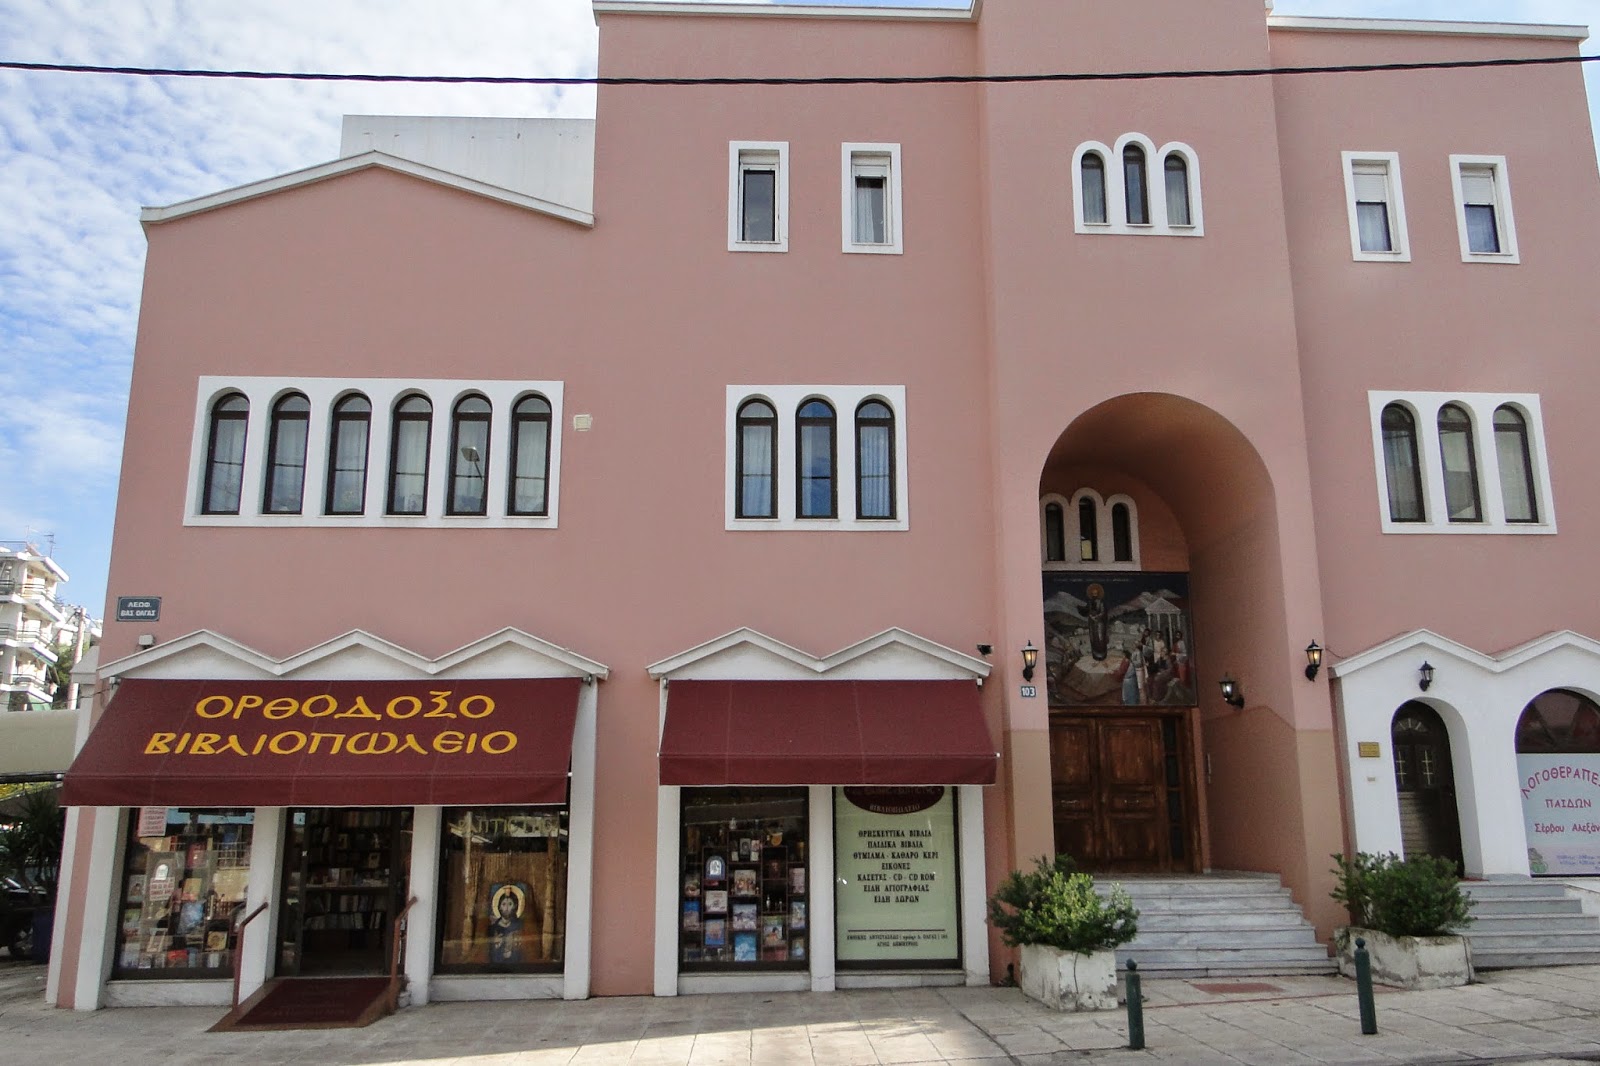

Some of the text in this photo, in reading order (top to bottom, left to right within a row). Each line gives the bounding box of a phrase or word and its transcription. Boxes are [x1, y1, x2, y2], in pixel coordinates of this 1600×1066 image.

[1021, 687, 1035, 697] 103
[195, 690, 496, 721] ΟΡΘΟΔΟΞΟ
[144, 730, 518, 756] ΒΙΒΛΙΟΠΩΛΕΙΟ
[1521, 766, 1600, 799] ΛΟΓΟΘΕΡΑΠΕ
[1545, 799, 1592, 808] ΠΑΙΔΩΝ
[858, 830, 932, 838] ΘΡΗΣΚΕΥΤΙΚΑ ΒΙΒΛΙΑ
[867, 841, 923, 849] ΠΑΙΔΙΚΑ ΒΙΒΛΙΑ
[853, 852, 885, 860] ΘΥΜΙΑΜΑ
[891, 852, 919, 860] ΚΑΘΑΡΟ
[923, 852, 938, 860] ΚΕΡΙ
[881, 863, 911, 871] ΕΙΚΟΝΕΣ
[893, 874, 903, 882] CD
[908, 874, 918, 882] CD
[920, 874, 935, 882] ROM
[863, 885, 930, 893] ΕΙΔΗ ΑΓΙΟΓΡΑΦΙΑΣ
[874, 896, 920, 904] ΕΙΔΗ ΔΩΡΩΝ
